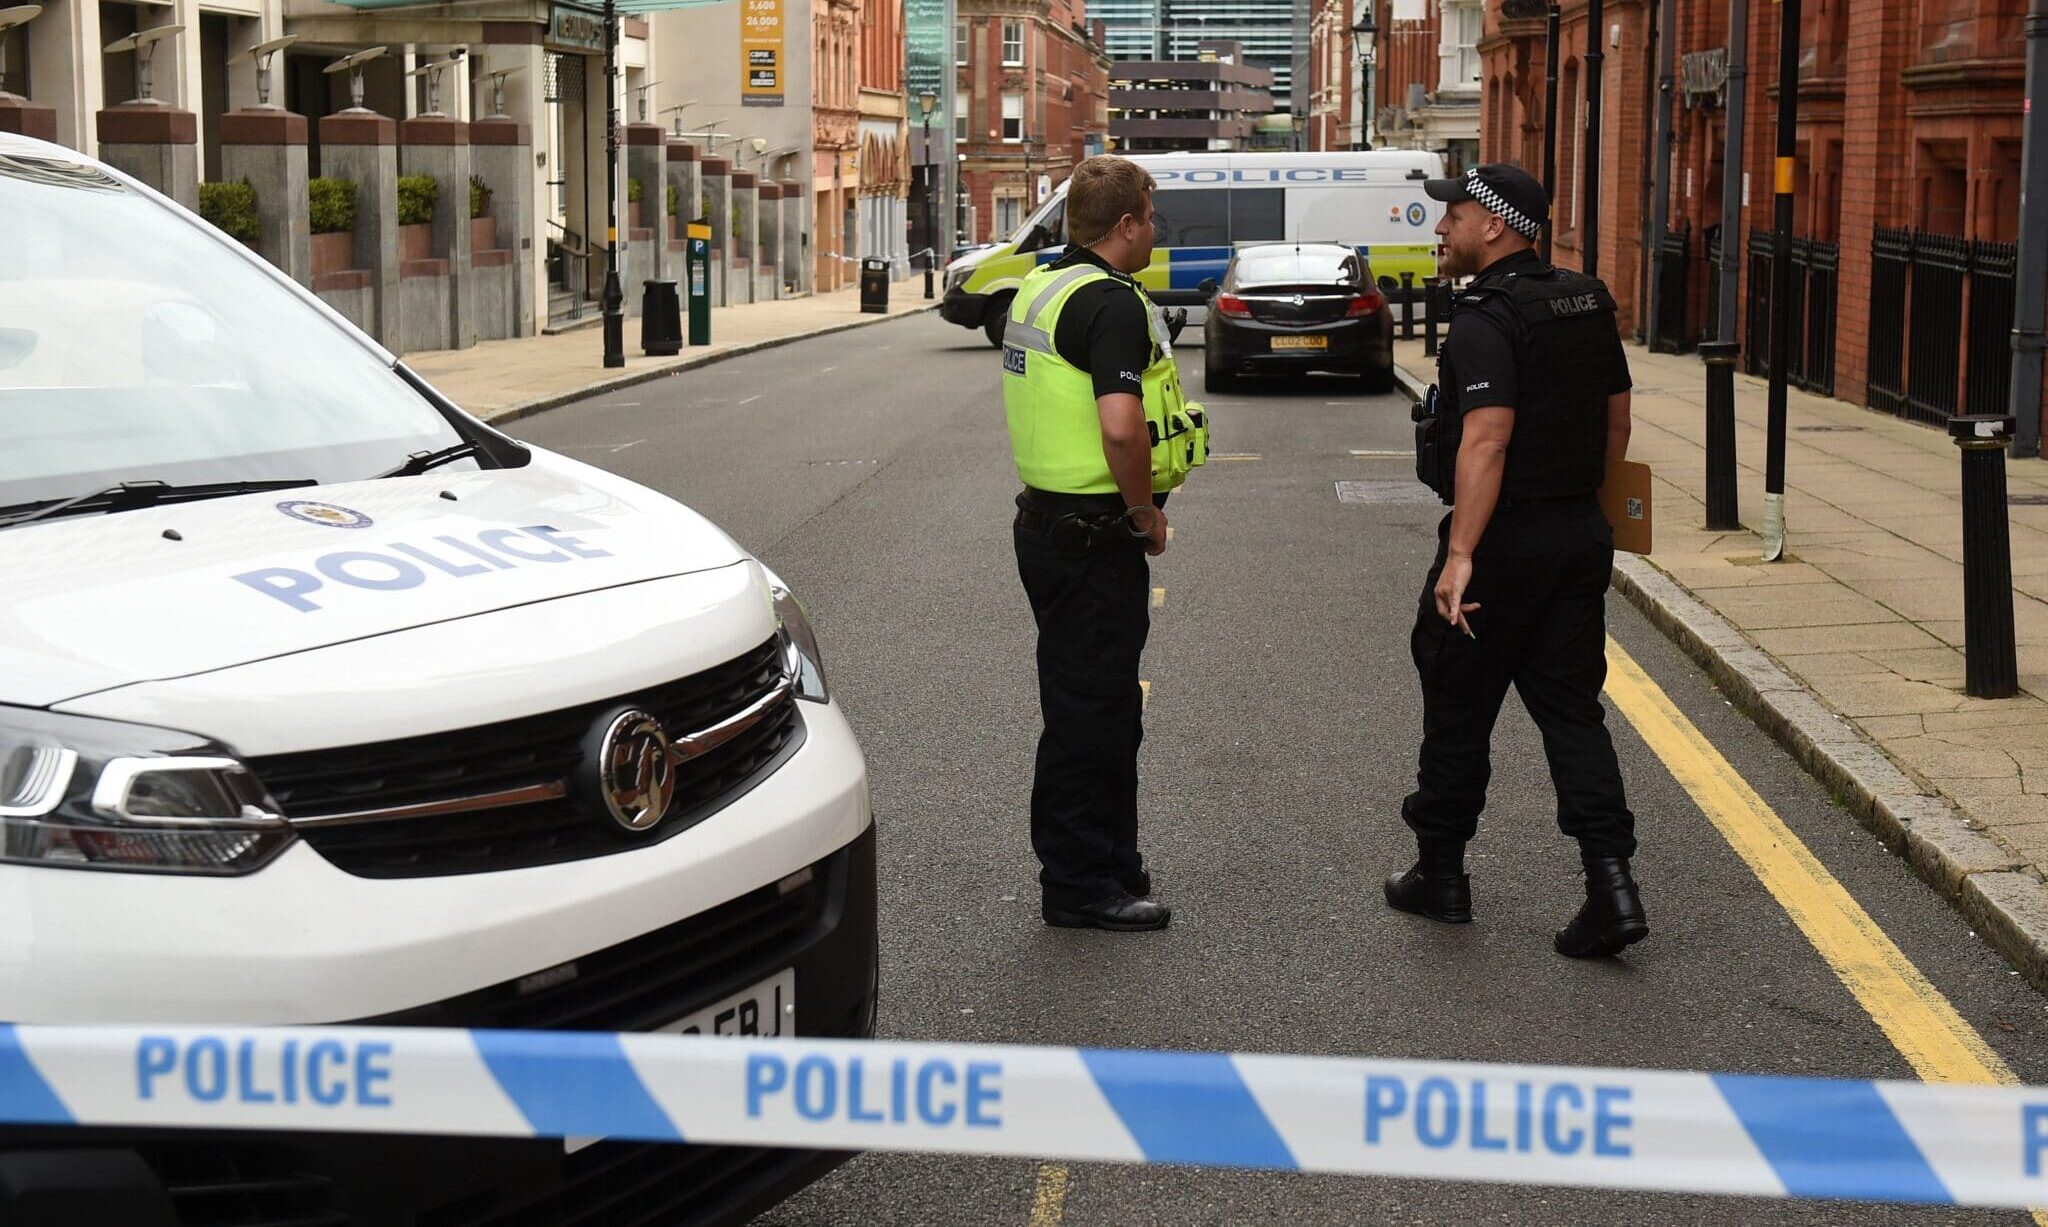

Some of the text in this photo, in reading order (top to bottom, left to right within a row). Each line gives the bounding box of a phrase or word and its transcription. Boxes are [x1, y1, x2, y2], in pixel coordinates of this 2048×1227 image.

[1151, 168, 1367, 183] POLICE
[695, 240, 704, 252] P
[1549, 293, 1599, 315] POLICE
[1003, 347, 1025, 372] OLICE
[1119, 370, 1141, 383] POLIC
[1466, 381, 1490, 393] POLICE
[230, 525, 614, 613] POLICE
[137, 1035, 394, 1107] POLICE
[745, 1053, 1003, 1128] POLICE
[1364, 1074, 1633, 1158] POLICE
